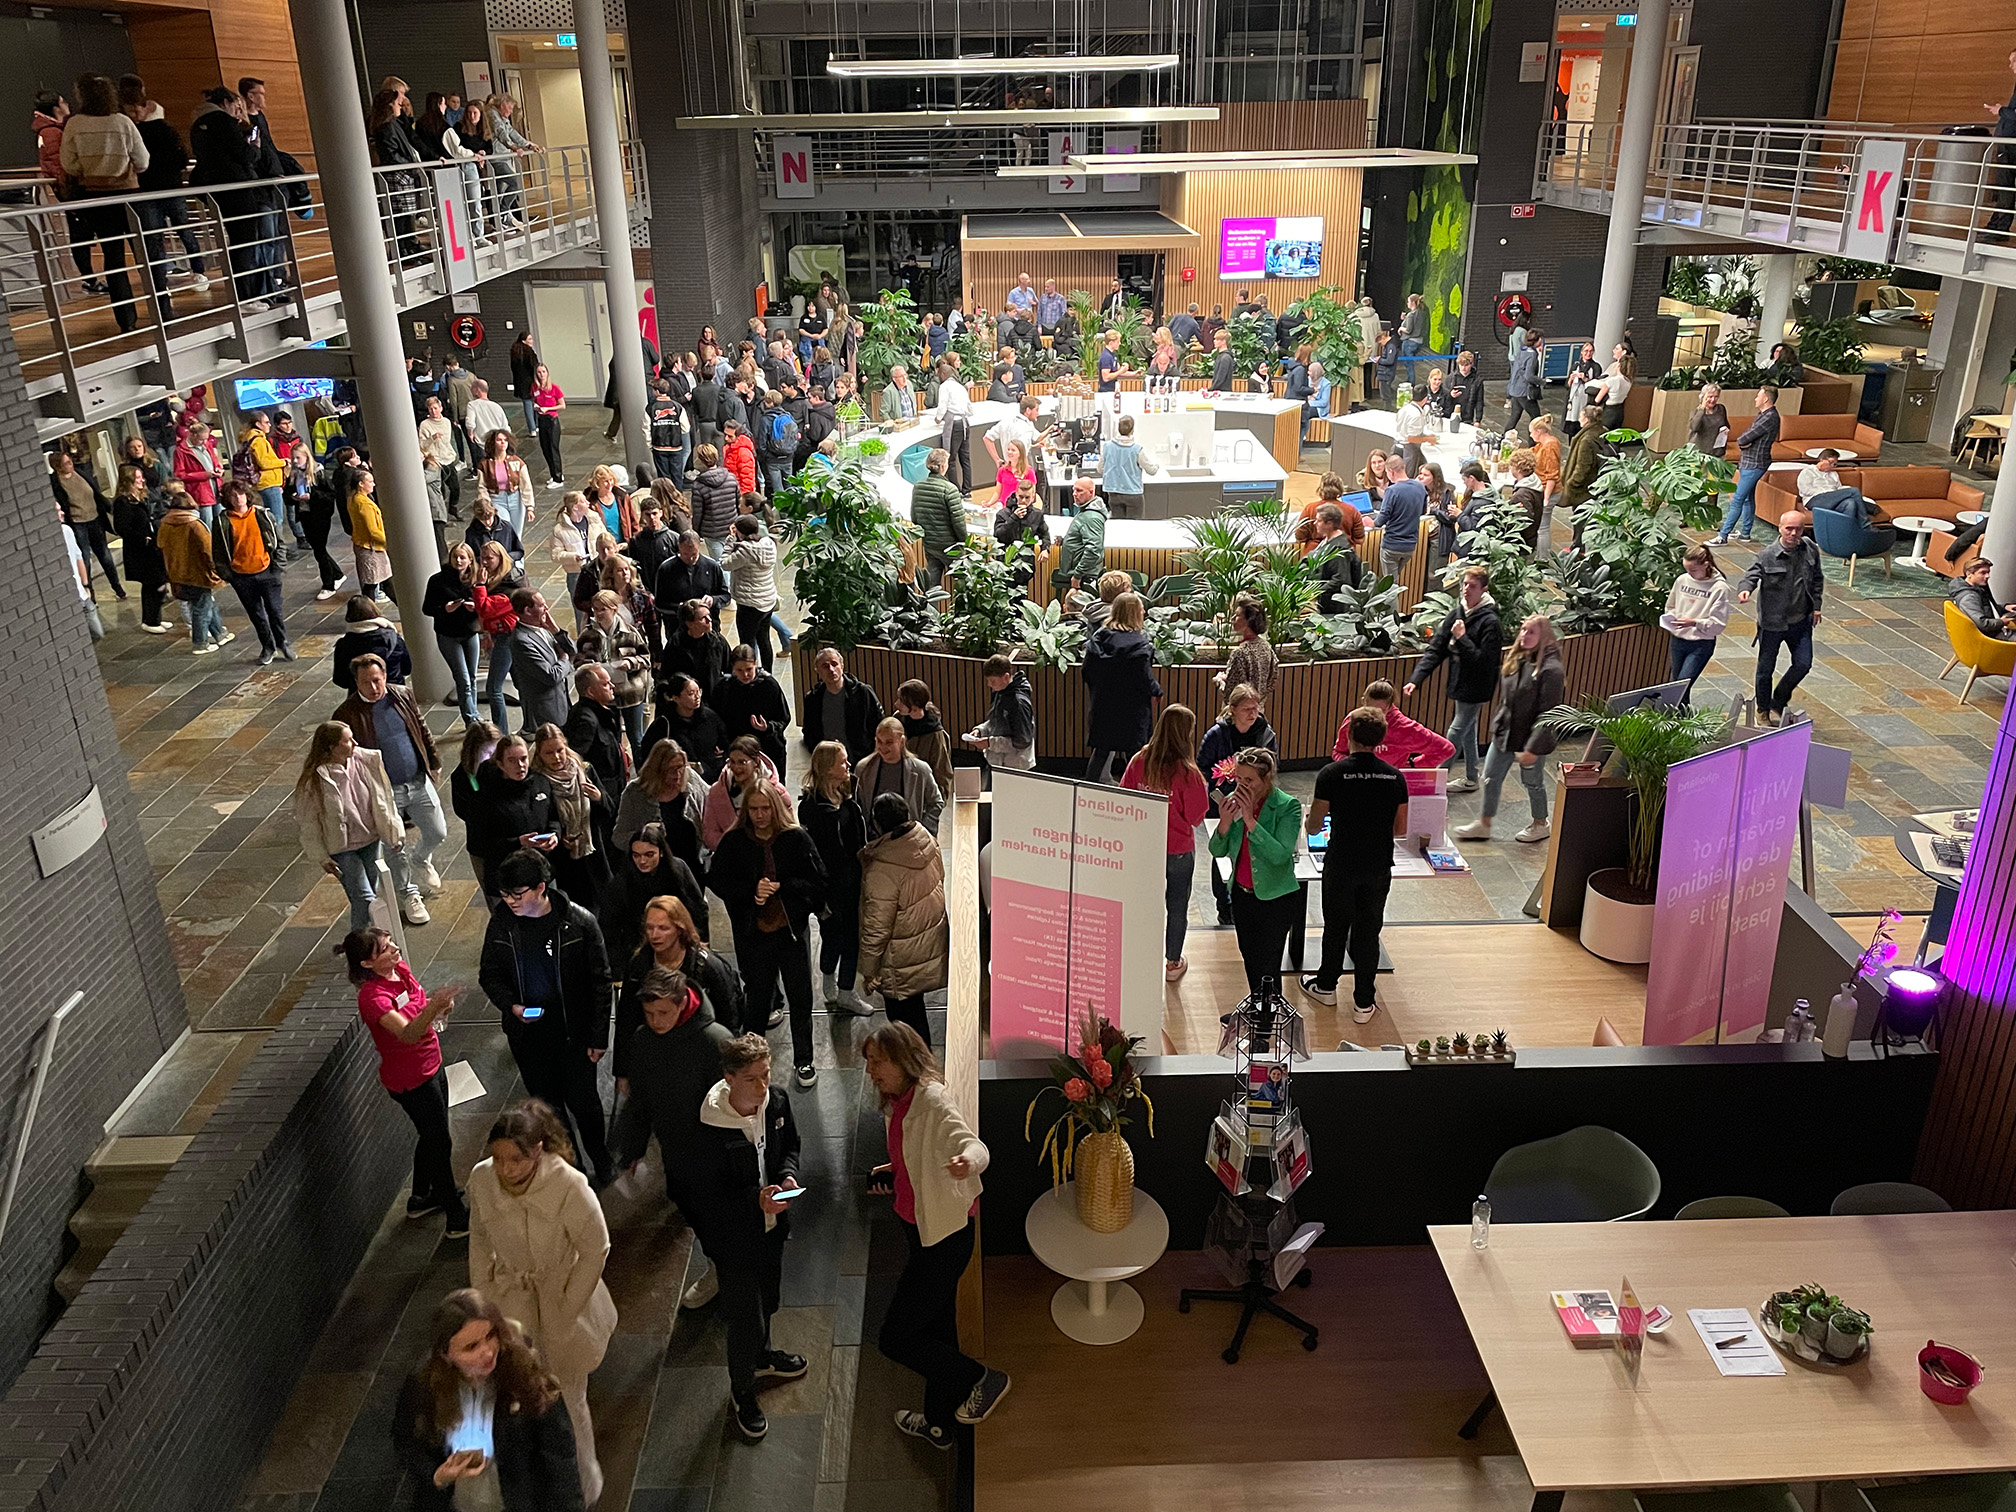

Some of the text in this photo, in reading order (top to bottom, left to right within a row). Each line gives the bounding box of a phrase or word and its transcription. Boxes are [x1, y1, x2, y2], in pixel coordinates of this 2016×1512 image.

[1536, 54, 1546, 62] M1
[780, 151, 808, 184] N
[1857, 170, 1893, 232] K
[444, 199, 465, 262] L
